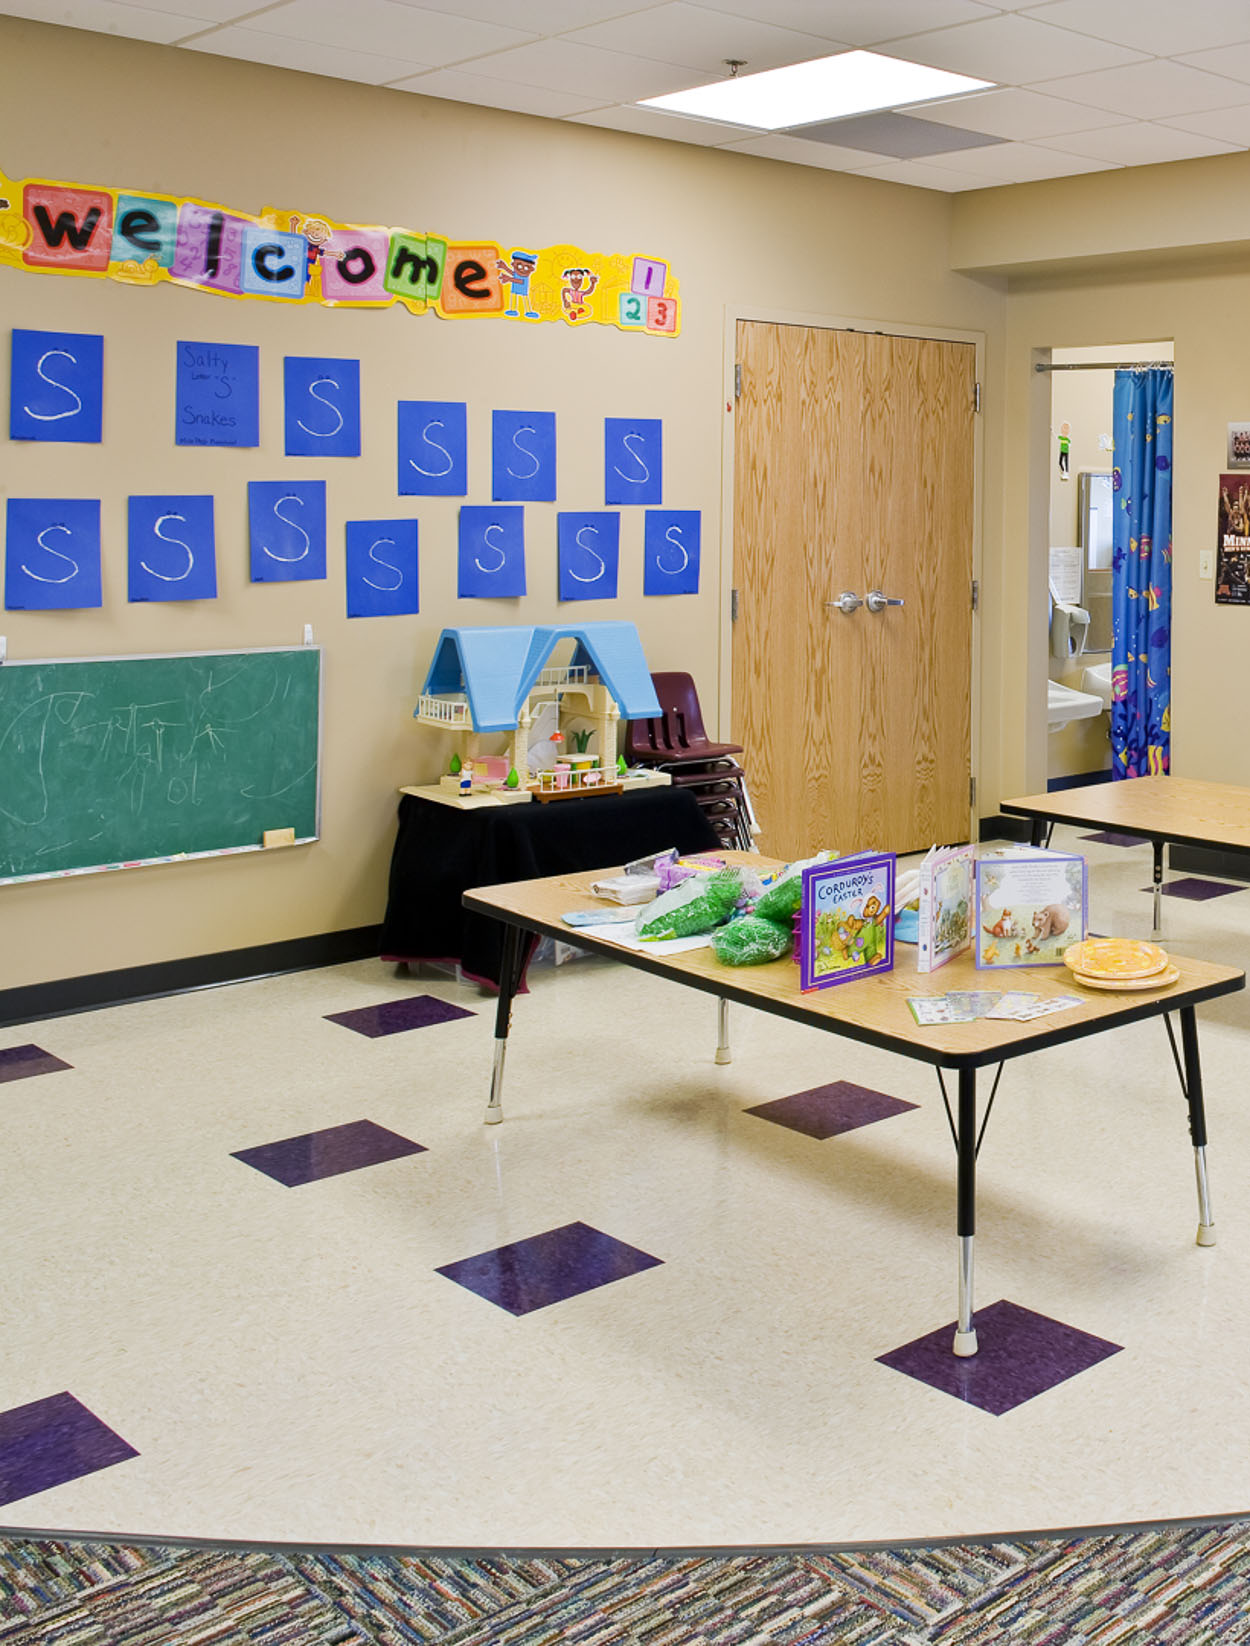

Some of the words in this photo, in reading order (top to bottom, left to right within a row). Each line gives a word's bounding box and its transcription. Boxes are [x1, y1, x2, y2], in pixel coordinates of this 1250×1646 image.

[33, 205, 491, 299] welcome
[626, 297, 641, 321] 2
[654, 302, 668, 326] 3
[23, 350, 82, 421] S
[183, 345, 229, 374] Salty
[182, 404, 237, 427] Snakes
[297, 378, 344, 437] S
[409, 421, 454, 477] S
[507, 427, 540, 480] S
[613, 433, 650, 484] S
[21, 525, 79, 584] S
[140, 514, 194, 582] S
[263, 496, 310, 562] S
[474, 525, 506, 573] S
[568, 526, 606, 583] S
[656, 525, 689, 575] S
[362, 538, 404, 591] S
[818, 871, 874, 900] CORDUROY'S
[833, 888, 864, 905] EASTER
